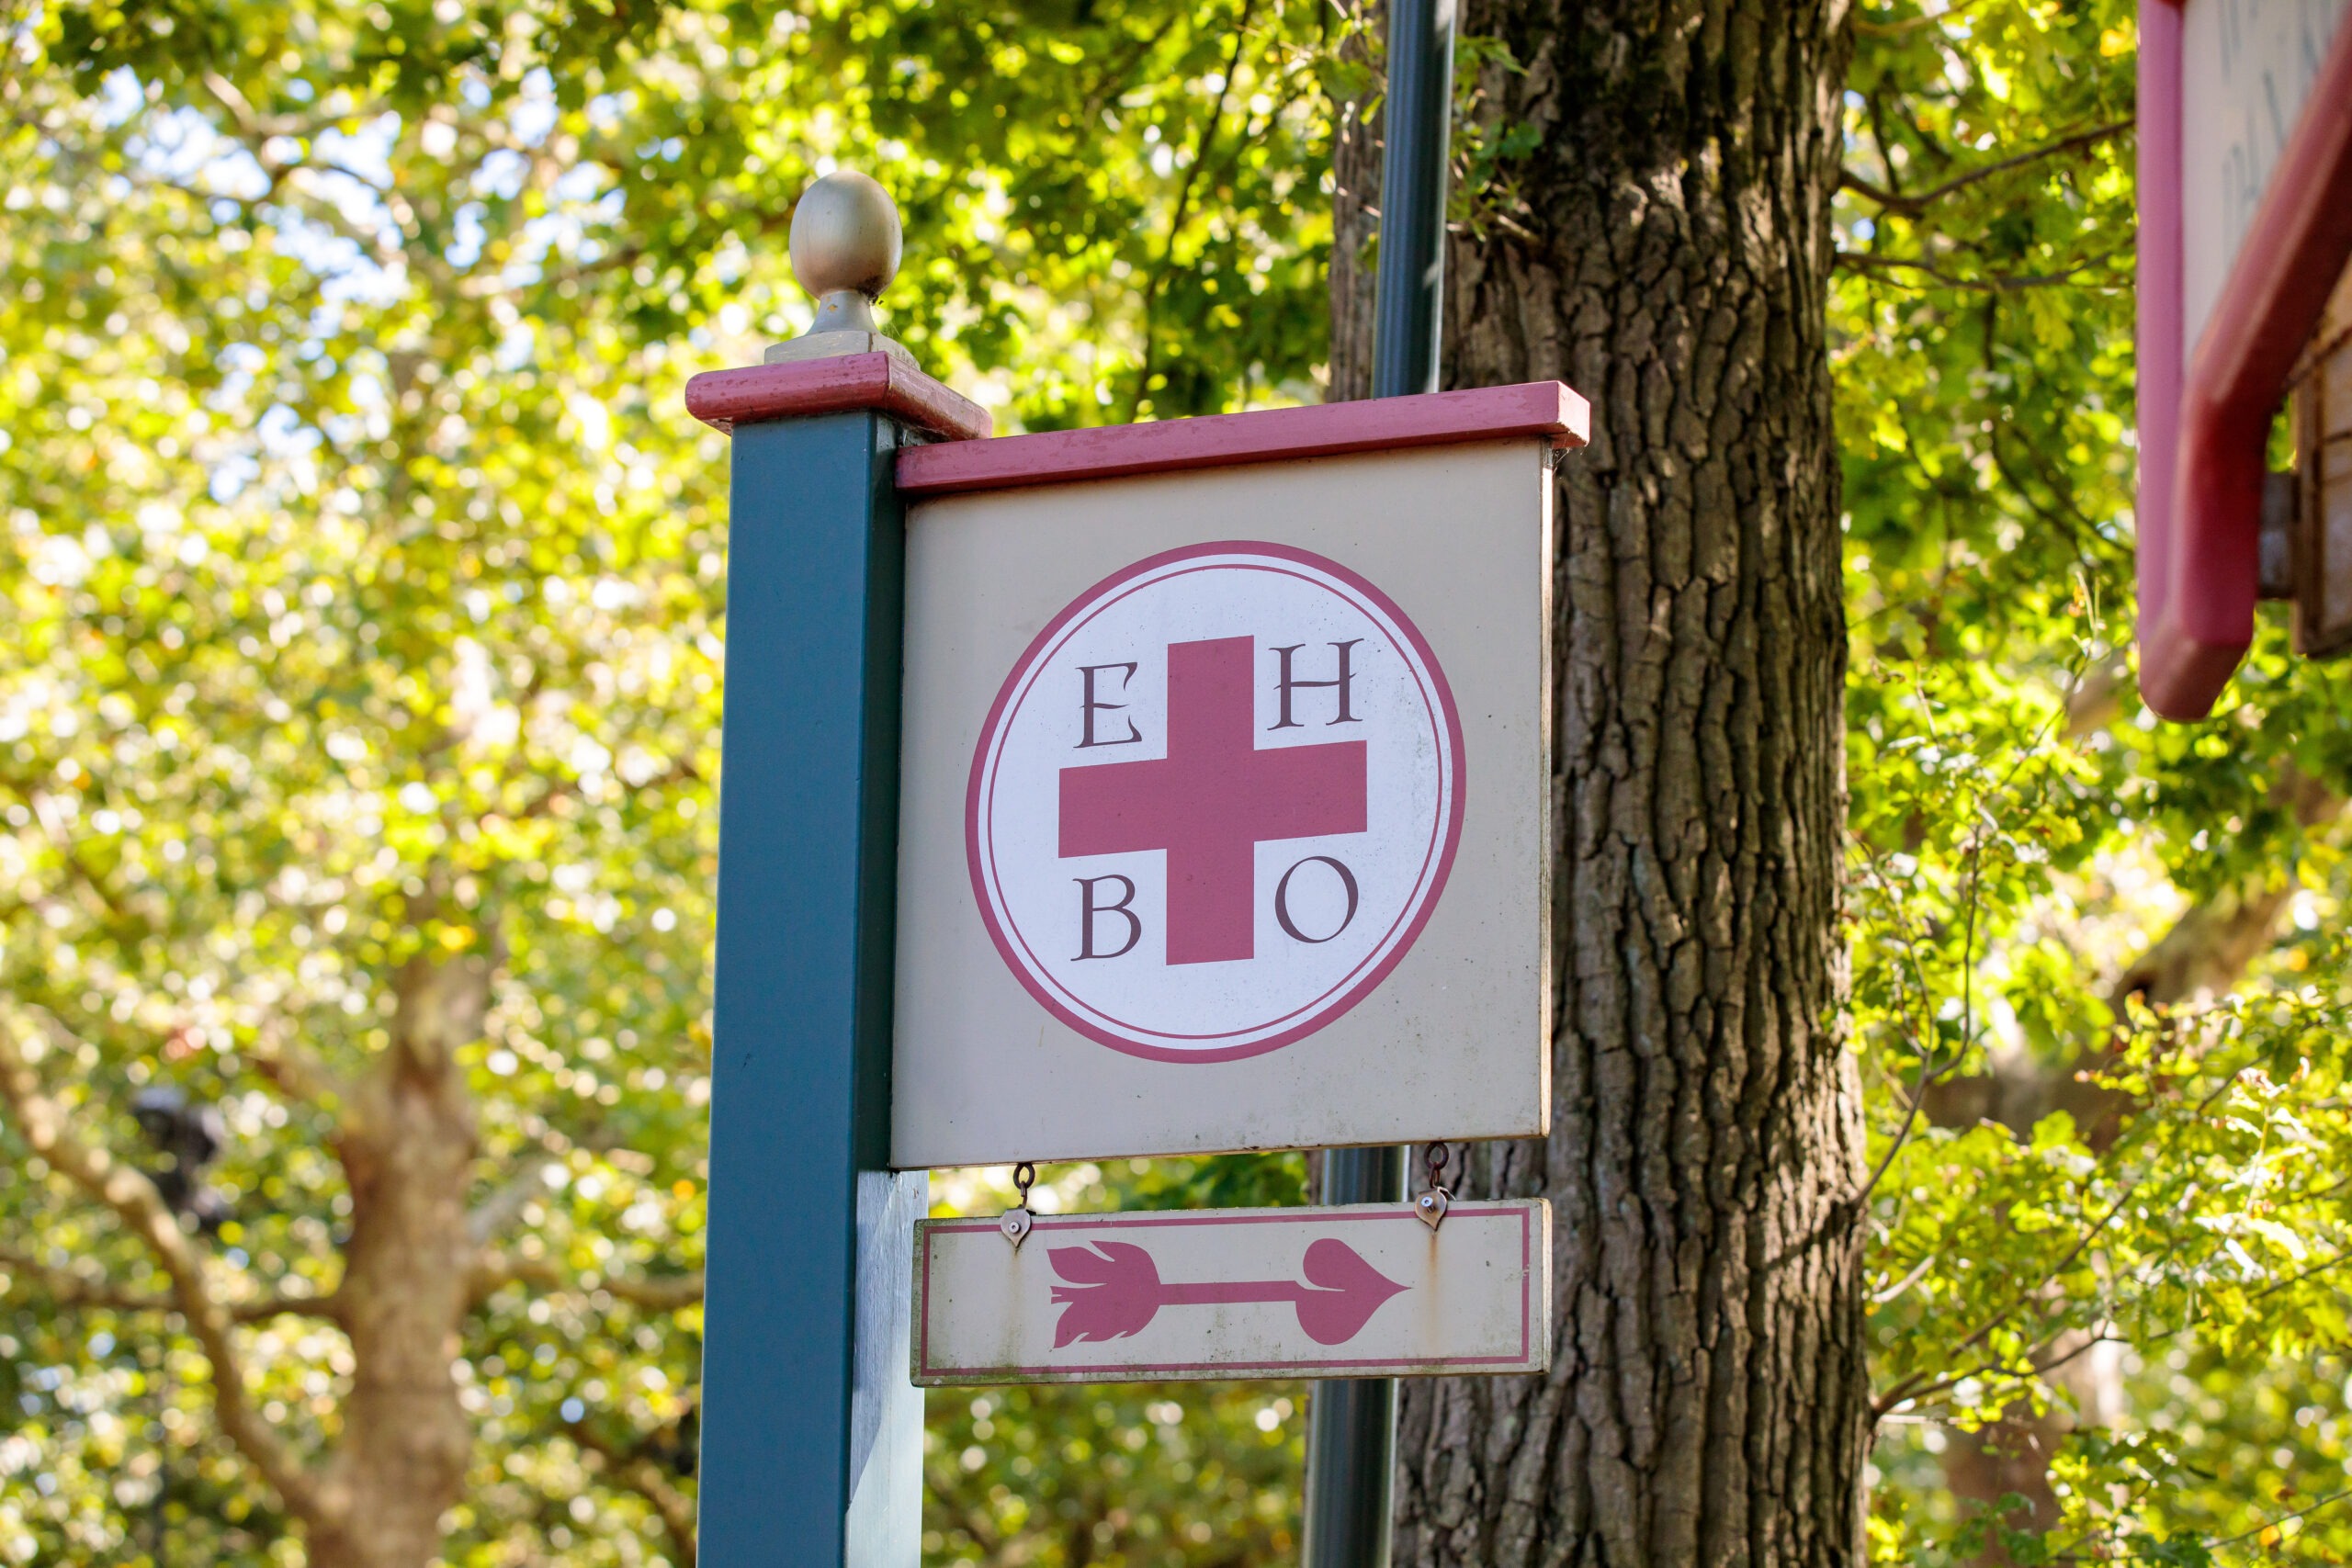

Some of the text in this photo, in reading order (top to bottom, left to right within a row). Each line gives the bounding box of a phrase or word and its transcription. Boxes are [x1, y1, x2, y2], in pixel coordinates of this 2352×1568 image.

[1073, 637, 1365, 749] E H
[1069, 855, 1359, 962] B O
